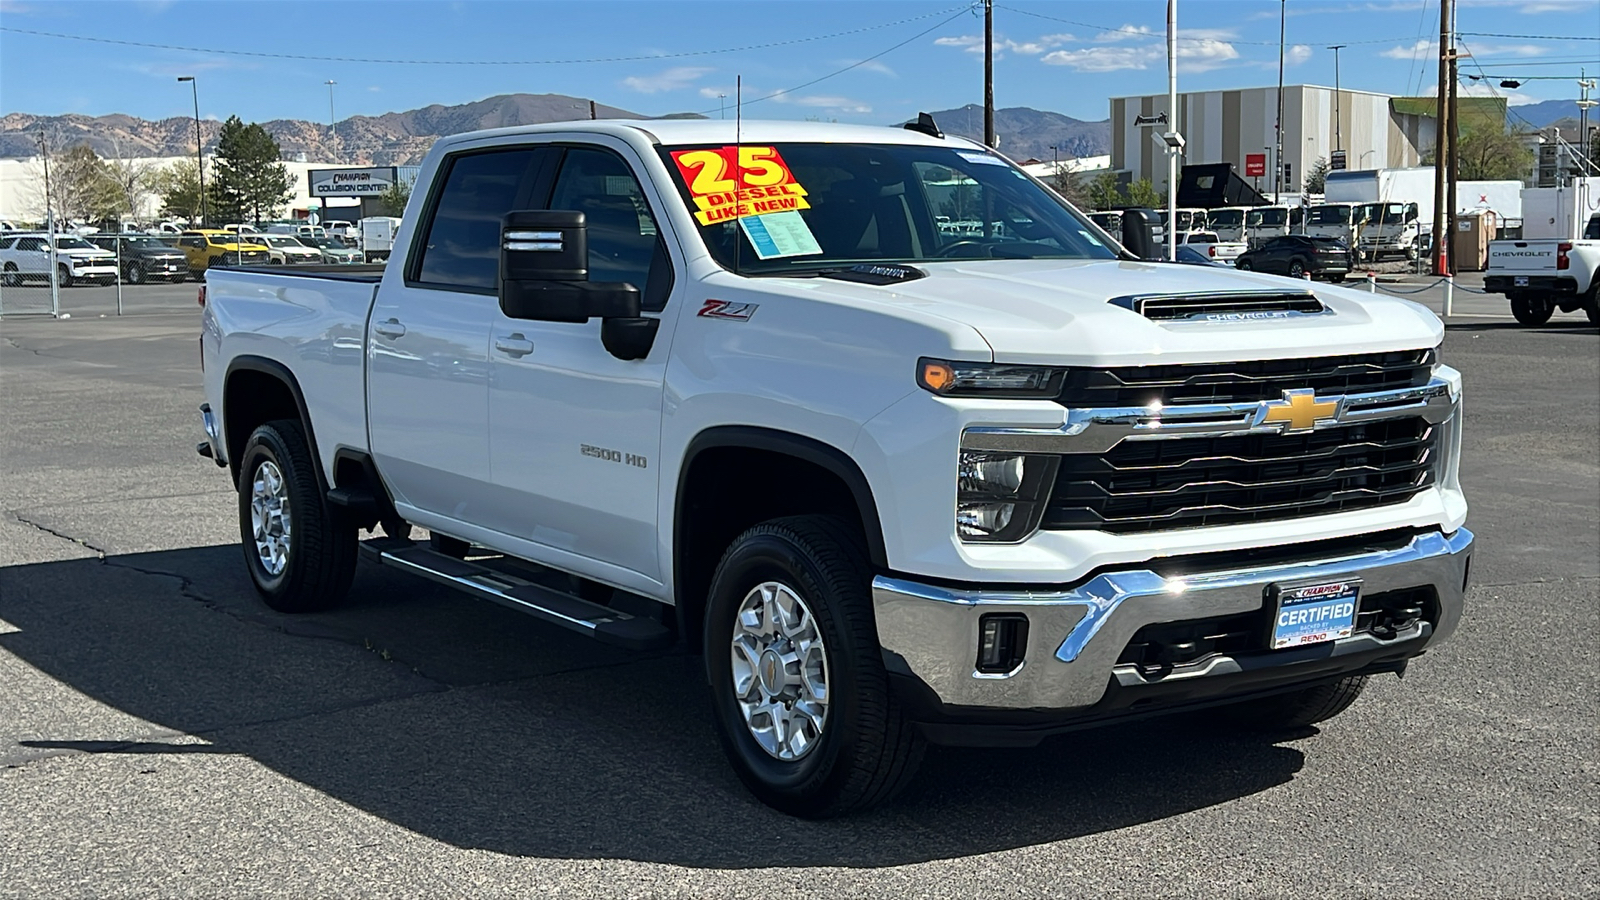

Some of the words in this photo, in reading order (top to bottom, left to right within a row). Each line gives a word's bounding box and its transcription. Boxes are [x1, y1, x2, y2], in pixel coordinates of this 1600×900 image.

[678, 146, 789, 194] 25
[333, 173, 371, 184] CHAMPION
[318, 184, 356, 193] COLLISION
[357, 183, 388, 192] CENTER
[707, 185, 797, 207] DIESEL
[705, 204, 749, 222] LIKE
[754, 197, 798, 213] NEW
[1206, 311, 1290, 321] CHEVROLET
[580, 443, 621, 463] 2500
[625, 453, 647, 469] HD
[1302, 585, 1341, 597] CHAMPION
[1278, 602, 1354, 627] CERTIFIED
[1300, 622, 1320, 631] BACKED
[1301, 633, 1327, 643] RENO
